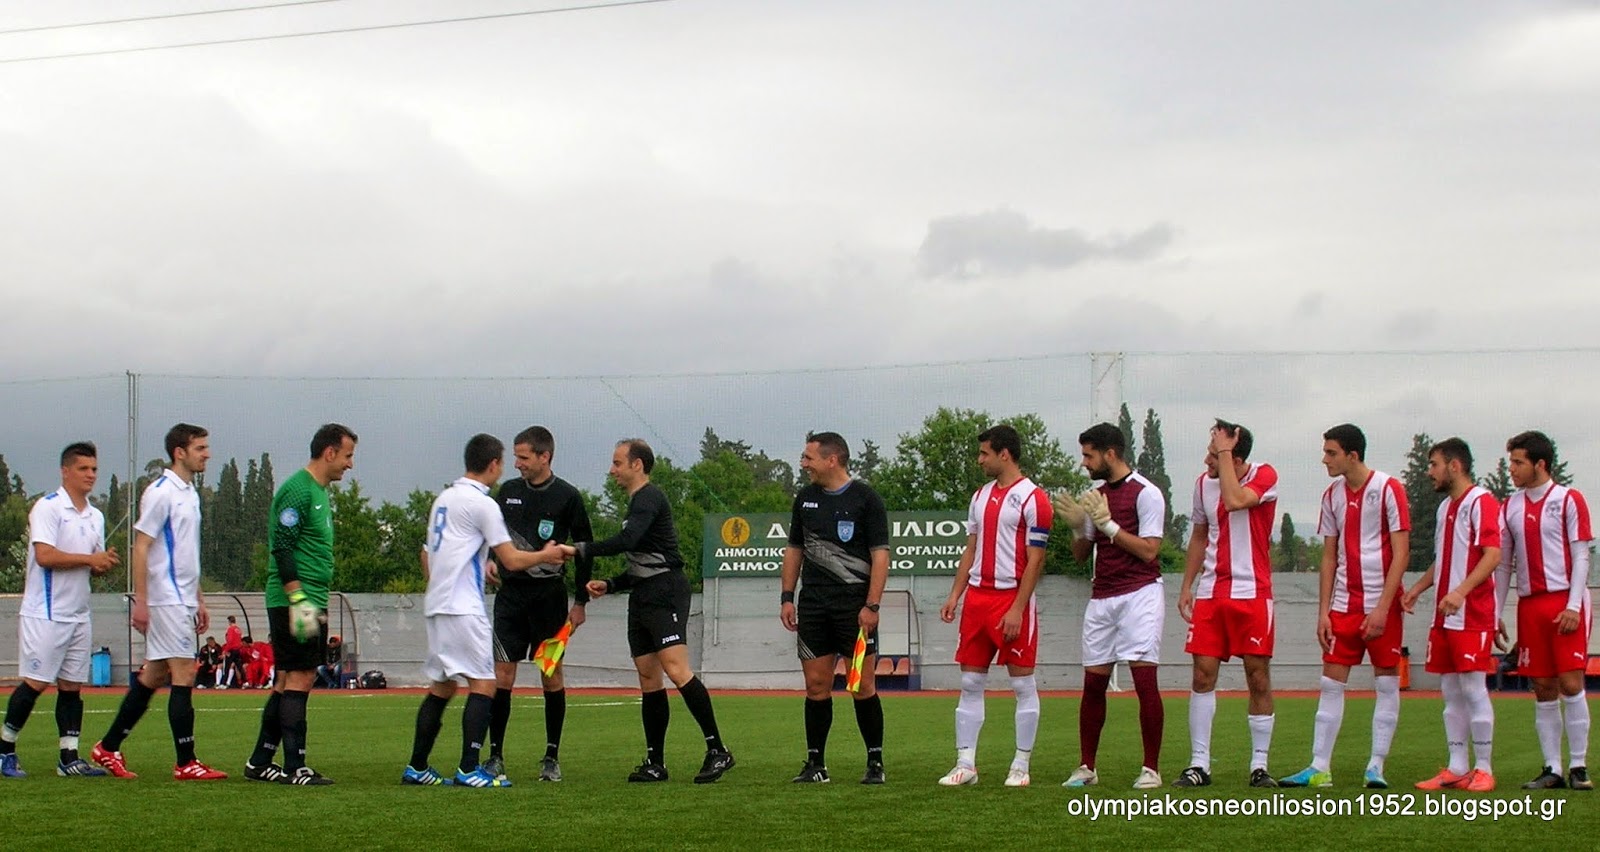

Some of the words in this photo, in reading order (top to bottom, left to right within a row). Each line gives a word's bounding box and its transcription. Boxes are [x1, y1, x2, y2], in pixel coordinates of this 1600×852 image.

[714, 547, 787, 558] ΔΗΜΟΤΙΚΟ
[895, 545, 967, 556] ΟΡΓΑΝΙΣΜ
[718, 561, 783, 571] ΔΗΜΟ
